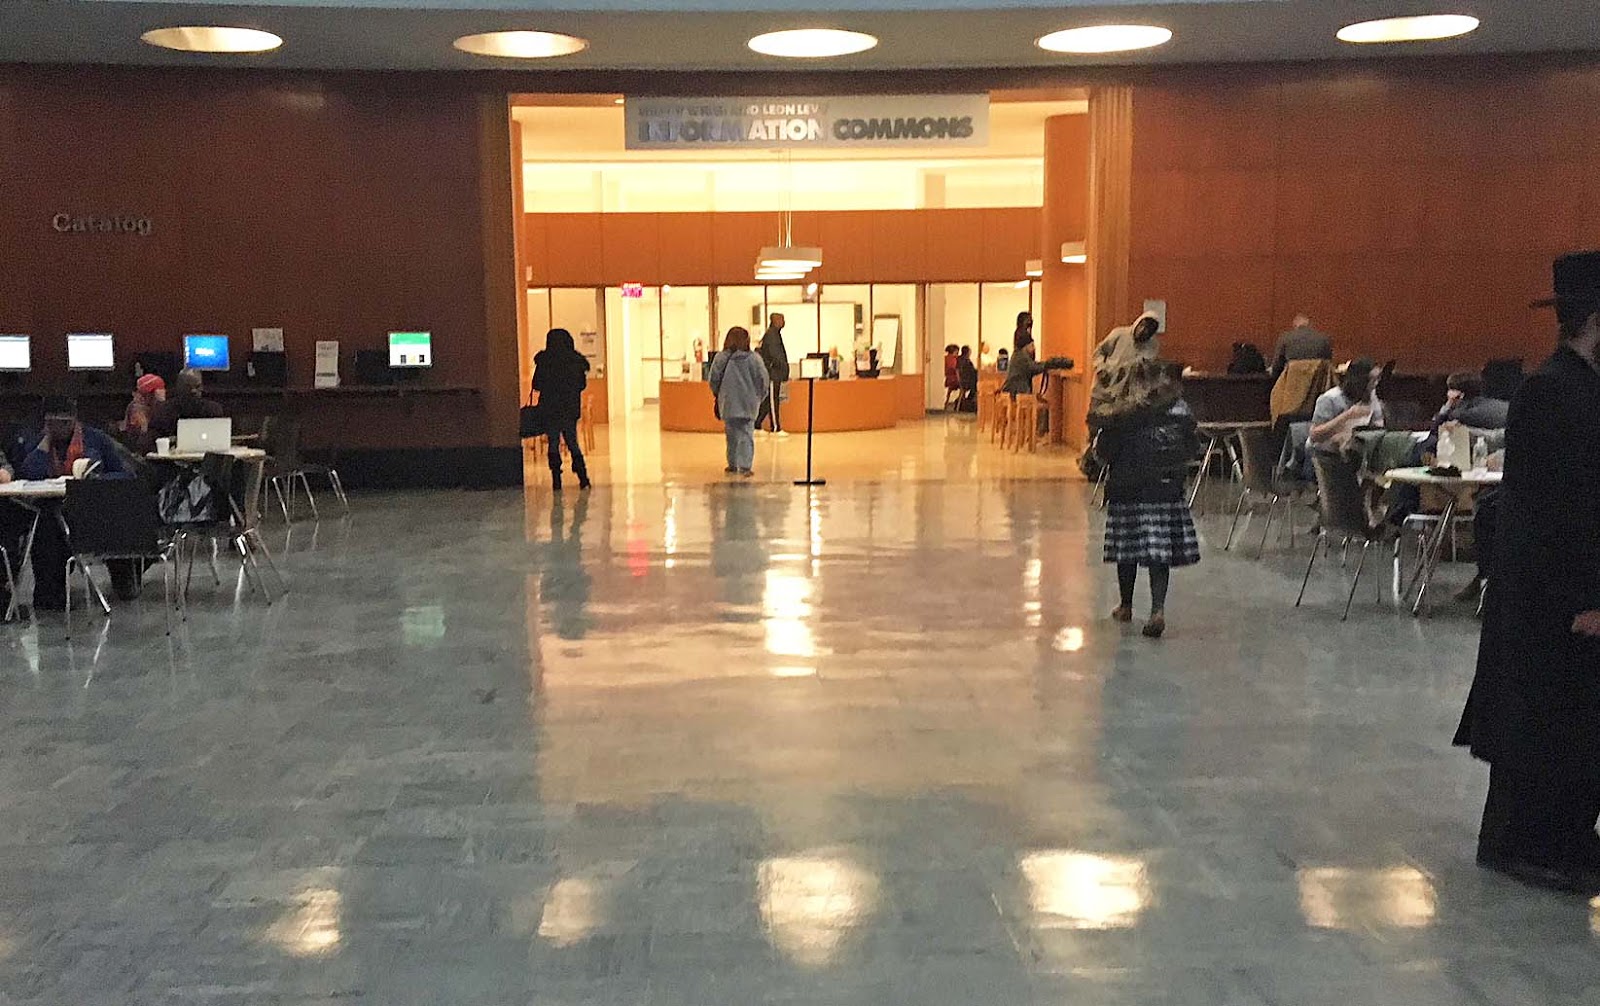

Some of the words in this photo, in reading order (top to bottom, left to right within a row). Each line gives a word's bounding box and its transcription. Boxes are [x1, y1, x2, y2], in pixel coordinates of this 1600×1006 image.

[762, 104, 795, 115] LEON
[797, 104, 826, 115] LEV
[834, 117, 973, 140] COMMONS
[52, 213, 152, 236] Catalog
